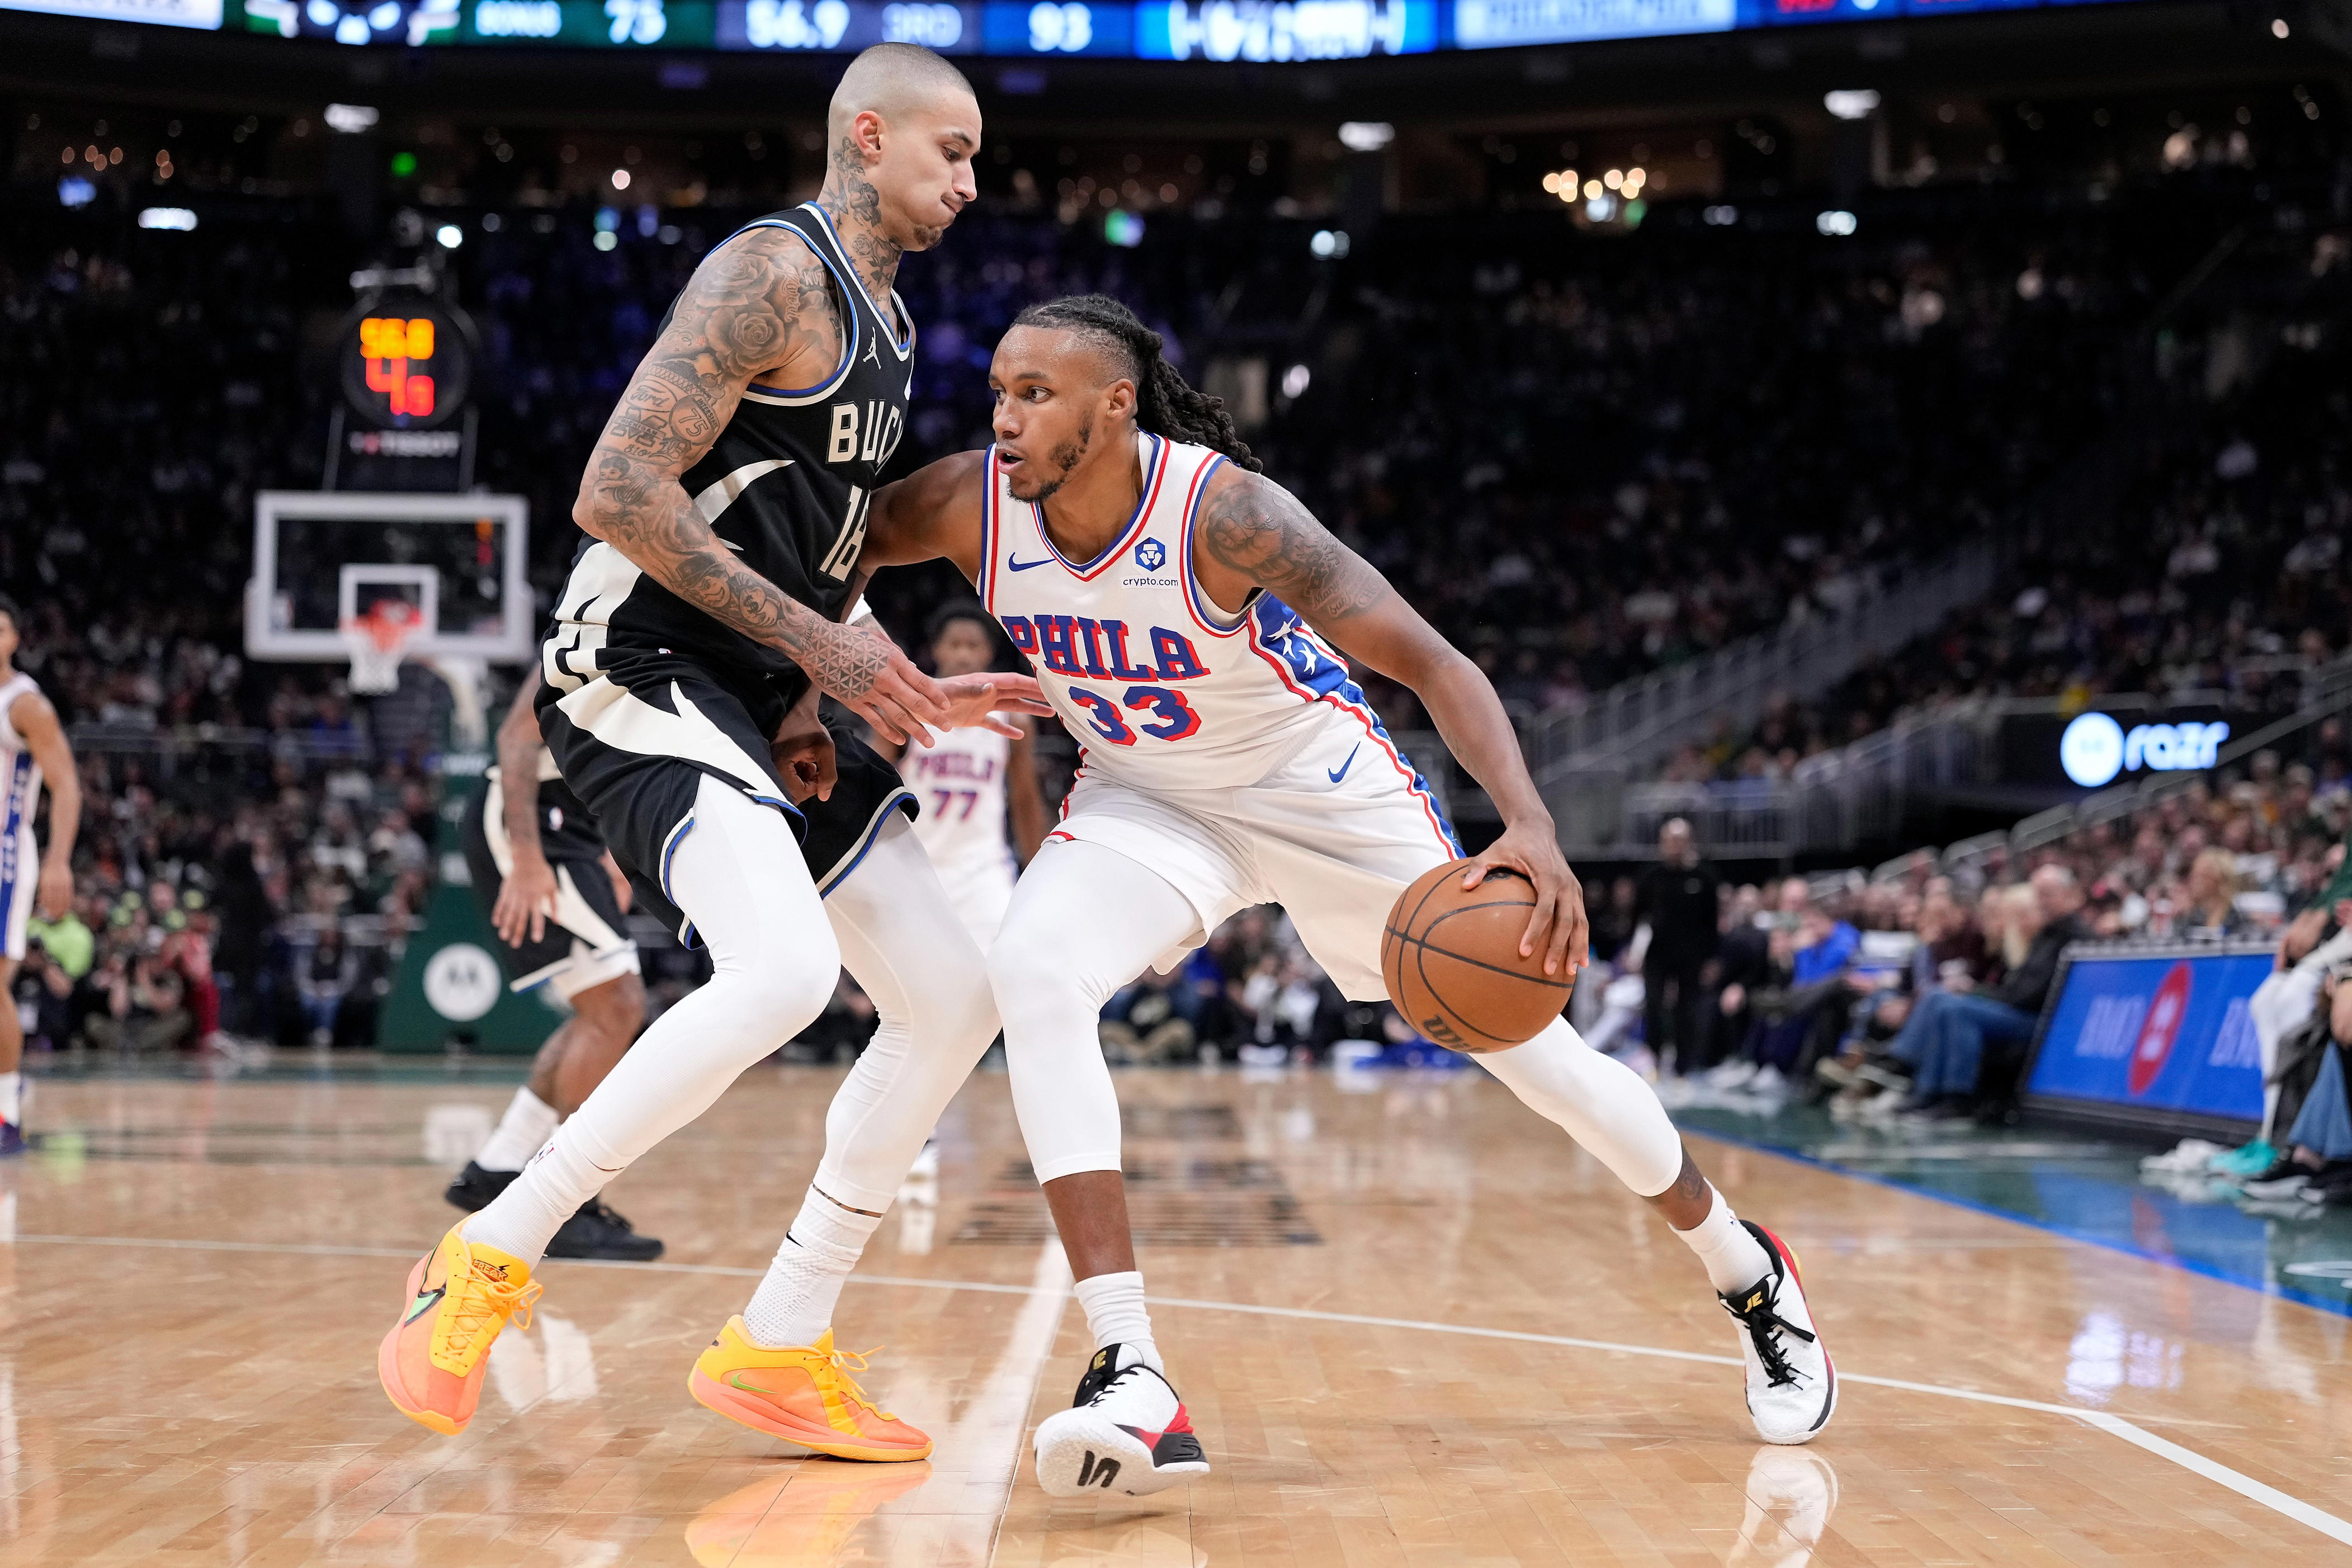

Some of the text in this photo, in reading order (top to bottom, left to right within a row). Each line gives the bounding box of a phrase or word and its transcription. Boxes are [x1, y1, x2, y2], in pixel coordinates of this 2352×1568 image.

[1029, 2, 1092, 52] 93
[630, 385, 672, 408] Ford
[678, 407, 710, 437] 75
[1123, 577, 1178, 587] crypto.com
[1001, 614, 1211, 682] PHILA
[1069, 686, 1202, 746] 33
[2125, 721, 2230, 772] razr
[933, 788, 978, 821] 77
[473, 1260, 507, 1282] FREAK
